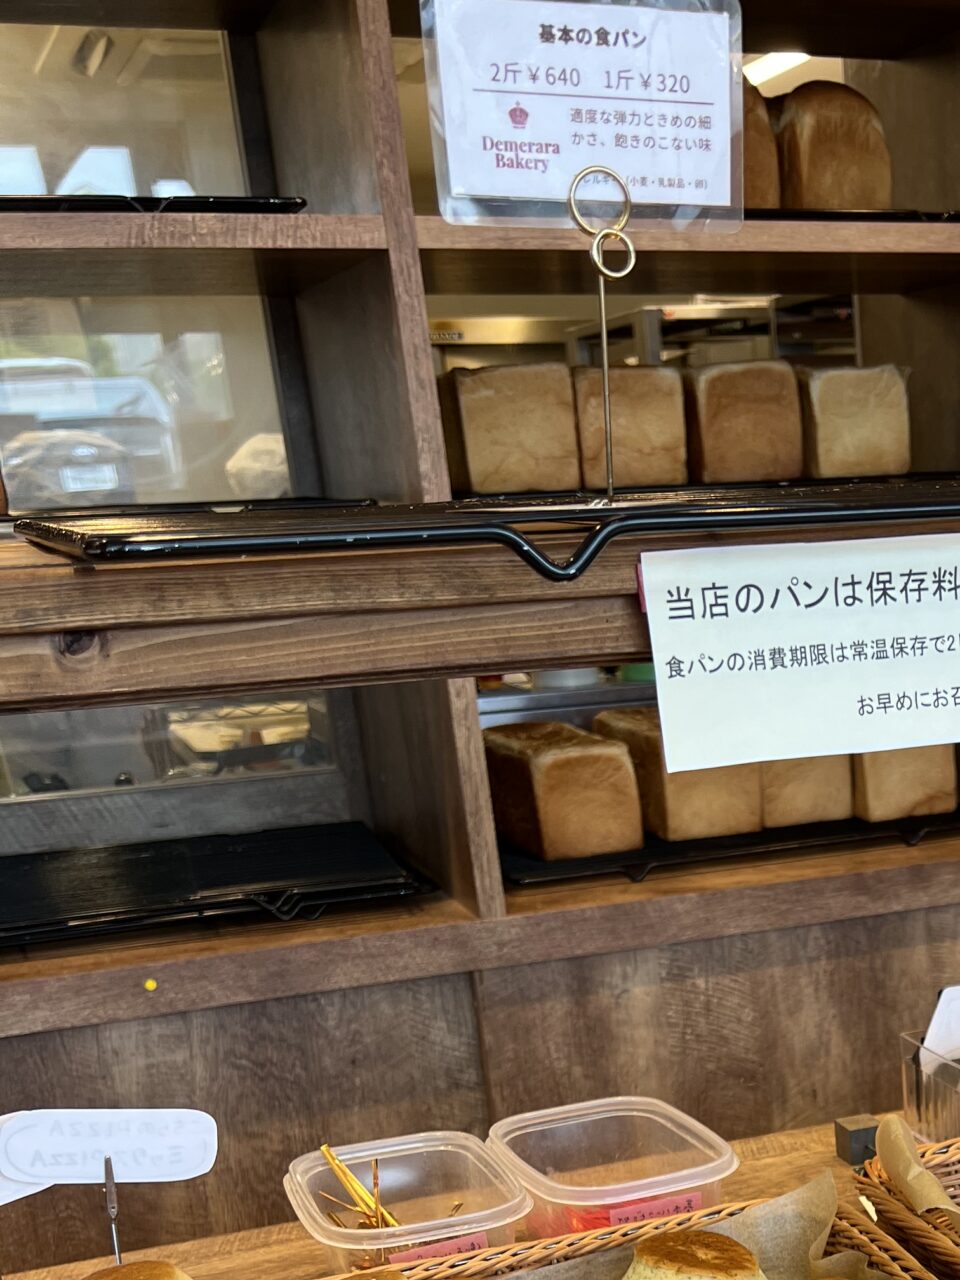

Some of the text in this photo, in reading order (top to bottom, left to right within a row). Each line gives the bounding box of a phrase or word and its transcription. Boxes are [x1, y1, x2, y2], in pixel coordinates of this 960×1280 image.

[538, 23, 647, 49] 基本の食パン
[570, 107, 712, 130] 適度な弾力ときめの細
[482, 135, 561, 155] Demerara
[571, 132, 712, 153] かさ、飽きのこない味
[495, 153, 550, 173] Bakery
